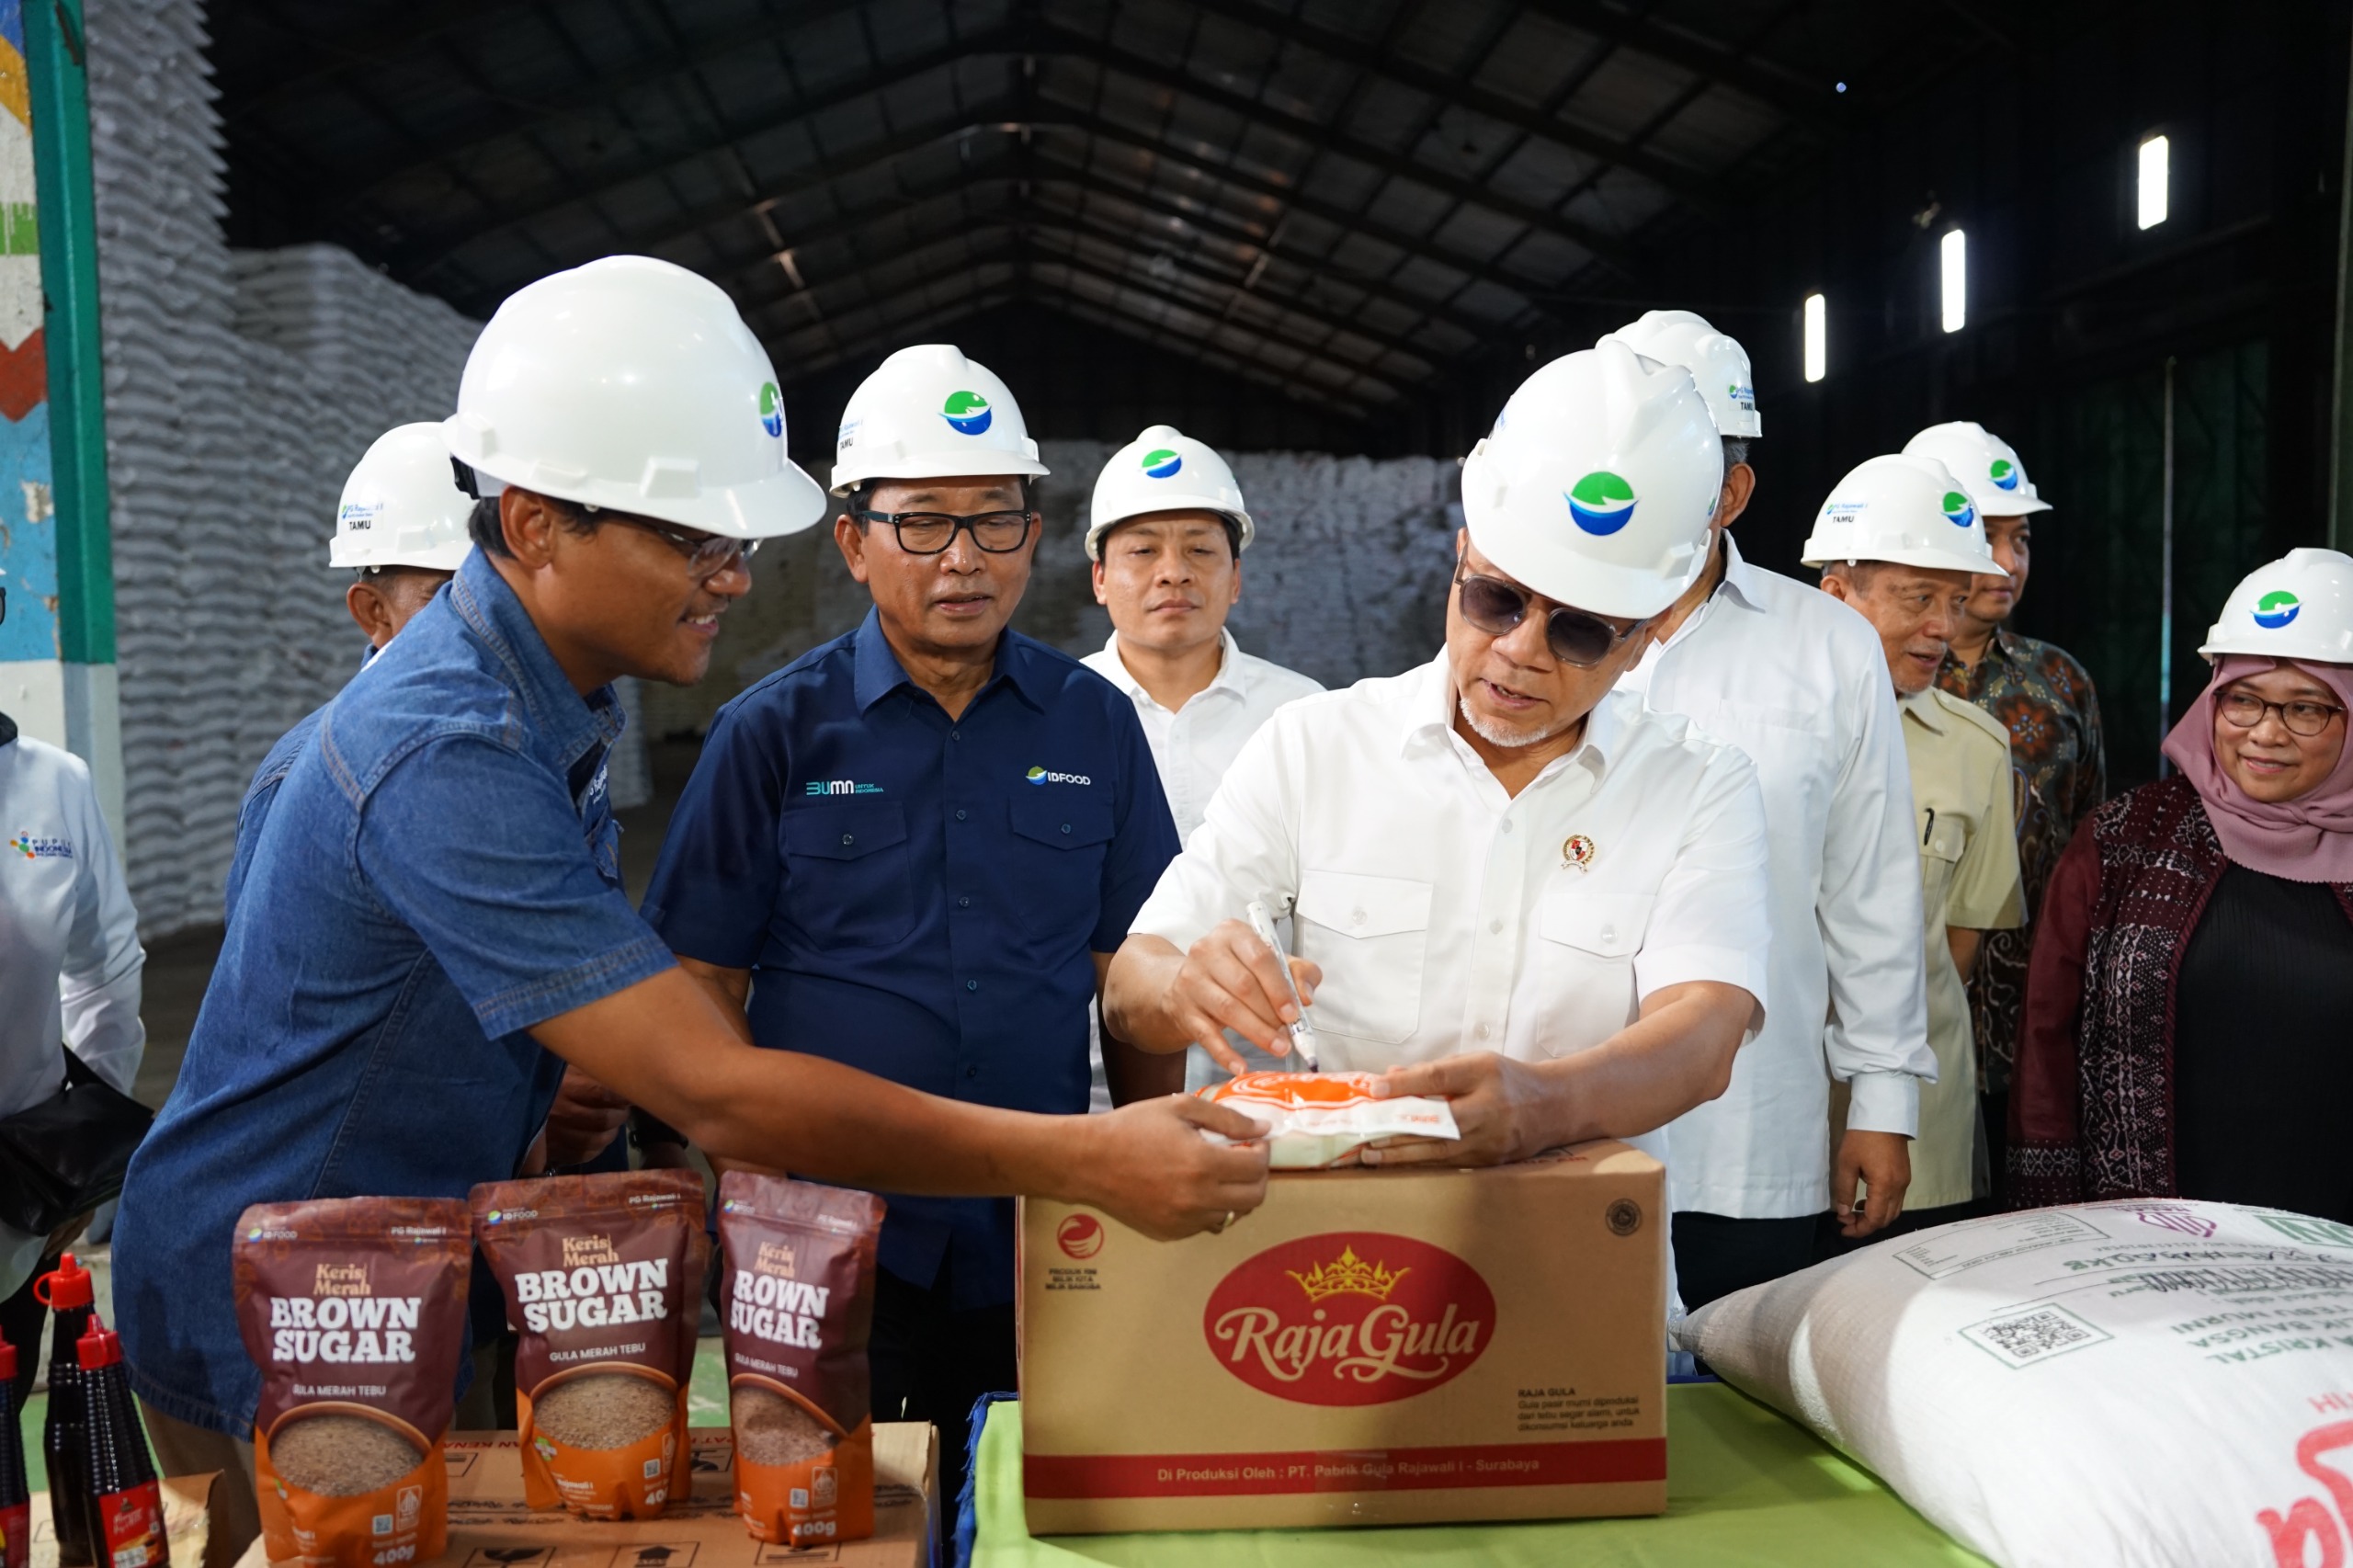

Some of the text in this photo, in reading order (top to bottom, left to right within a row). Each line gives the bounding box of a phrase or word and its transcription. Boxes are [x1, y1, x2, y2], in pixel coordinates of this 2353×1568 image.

[349, 519, 371, 530] TAMU
[1833, 515, 1855, 523] TAMU
[562, 1234, 608, 1253] Keris
[563, 1248, 620, 1267] Merah
[315, 1263, 364, 1279] Keris
[515, 1258, 668, 1302] BROWN
[313, 1278, 371, 1297] Merah
[733, 1269, 830, 1319] ROWN
[270, 1297, 422, 1329] BROWN
[523, 1290, 667, 1333] SUGAR
[2170, 1304, 2349, 1335] TEBU MURNI
[730, 1298, 823, 1350] SUGAR
[2187, 1319, 2313, 1348] BANGSA
[272, 1329, 415, 1363] SUGAR
[550, 1343, 646, 1362] GULA MERAH TEBU
[2205, 1336, 2333, 1365] KRISTAL
[777, 1363, 799, 1378] TEBU
[317, 1385, 356, 1396] MERAH
[358, 1385, 387, 1396] TEBU
[1518, 1387, 1575, 1397] RAJA GULA
[1518, 1400, 1540, 1409] Gula
[1541, 1400, 1563, 1410] pasir
[1593, 1396, 1639, 1407] diproduksi
[1610, 1418, 1633, 1427] anda
[1157, 1469, 1173, 1482] Di
[1176, 1467, 1239, 1481] Produksi
[1243, 1466, 1276, 1480] Oleh
[1288, 1465, 1311, 1477] PT.
[1314, 1464, 1358, 1477] Pabrik
[1362, 1462, 1394, 1476] Gula
[1398, 1460, 1455, 1476] Rajawali
[1475, 1459, 1540, 1475] Surabaya
[645, 1489, 669, 1506] 40
